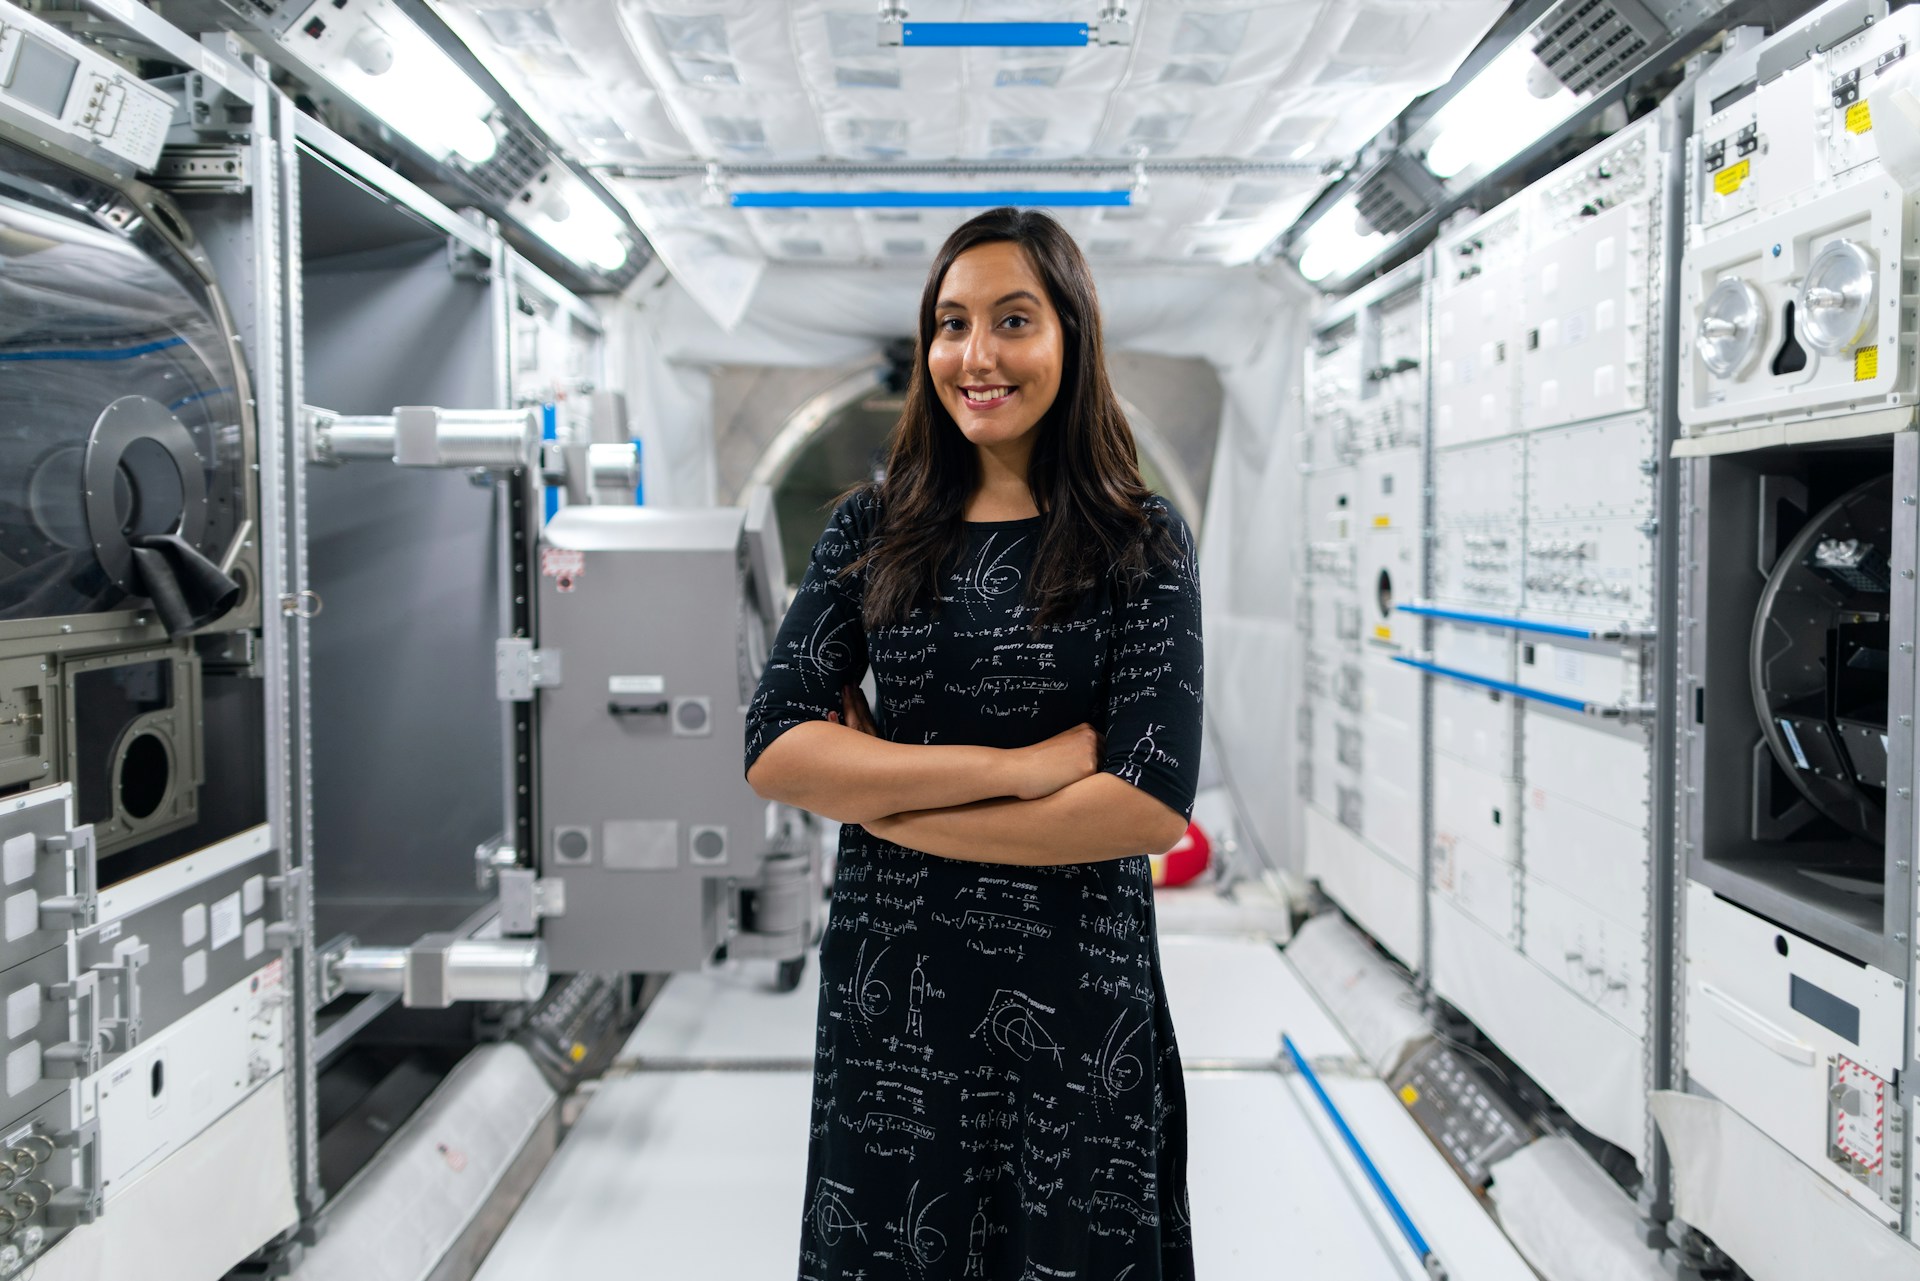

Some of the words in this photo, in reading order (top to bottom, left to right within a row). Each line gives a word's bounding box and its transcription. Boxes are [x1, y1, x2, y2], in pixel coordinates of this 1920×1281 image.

[994, 643, 1023, 651] GRAVITY
[978, 877, 1009, 885] GRAVITY
[1012, 882, 1038, 891] LOSSES
